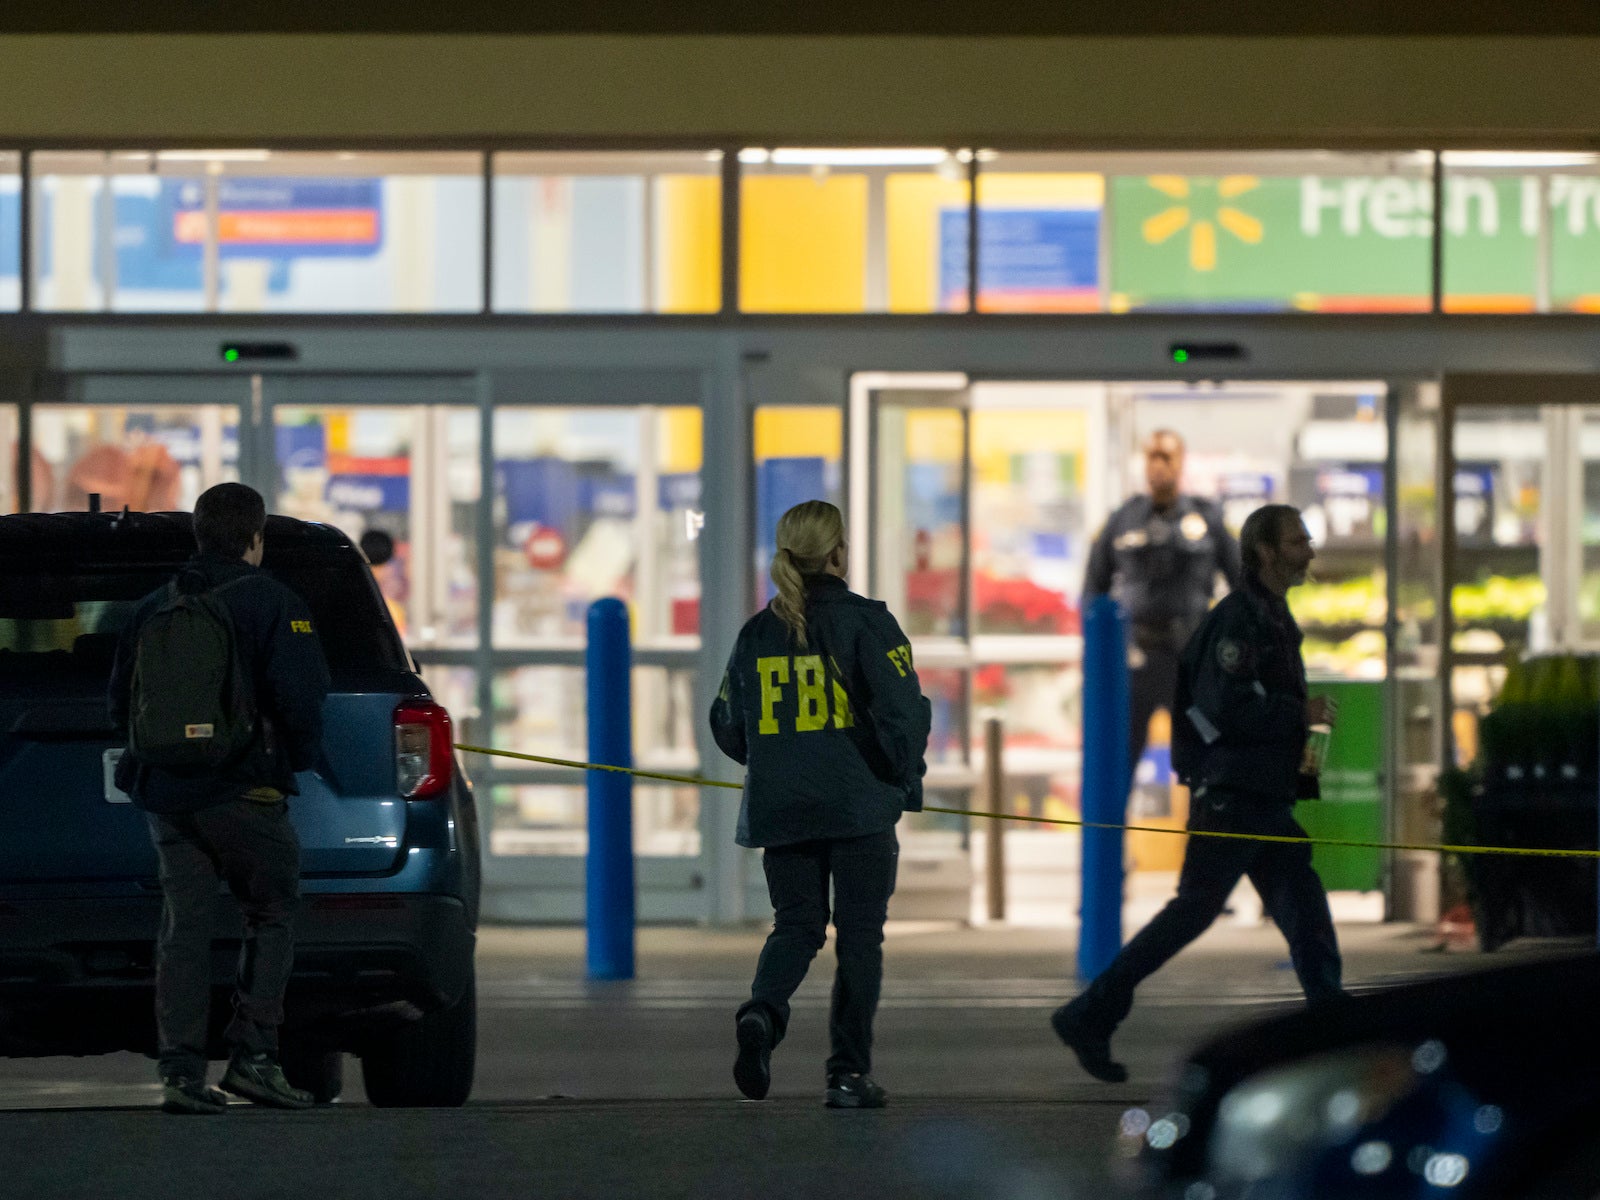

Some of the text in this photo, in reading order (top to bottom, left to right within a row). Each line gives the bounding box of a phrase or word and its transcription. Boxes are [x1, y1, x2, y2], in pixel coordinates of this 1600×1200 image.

[1520, 175, 1600, 236] Pr
[291, 621, 313, 633] FBI
[886, 644, 913, 677] FB
